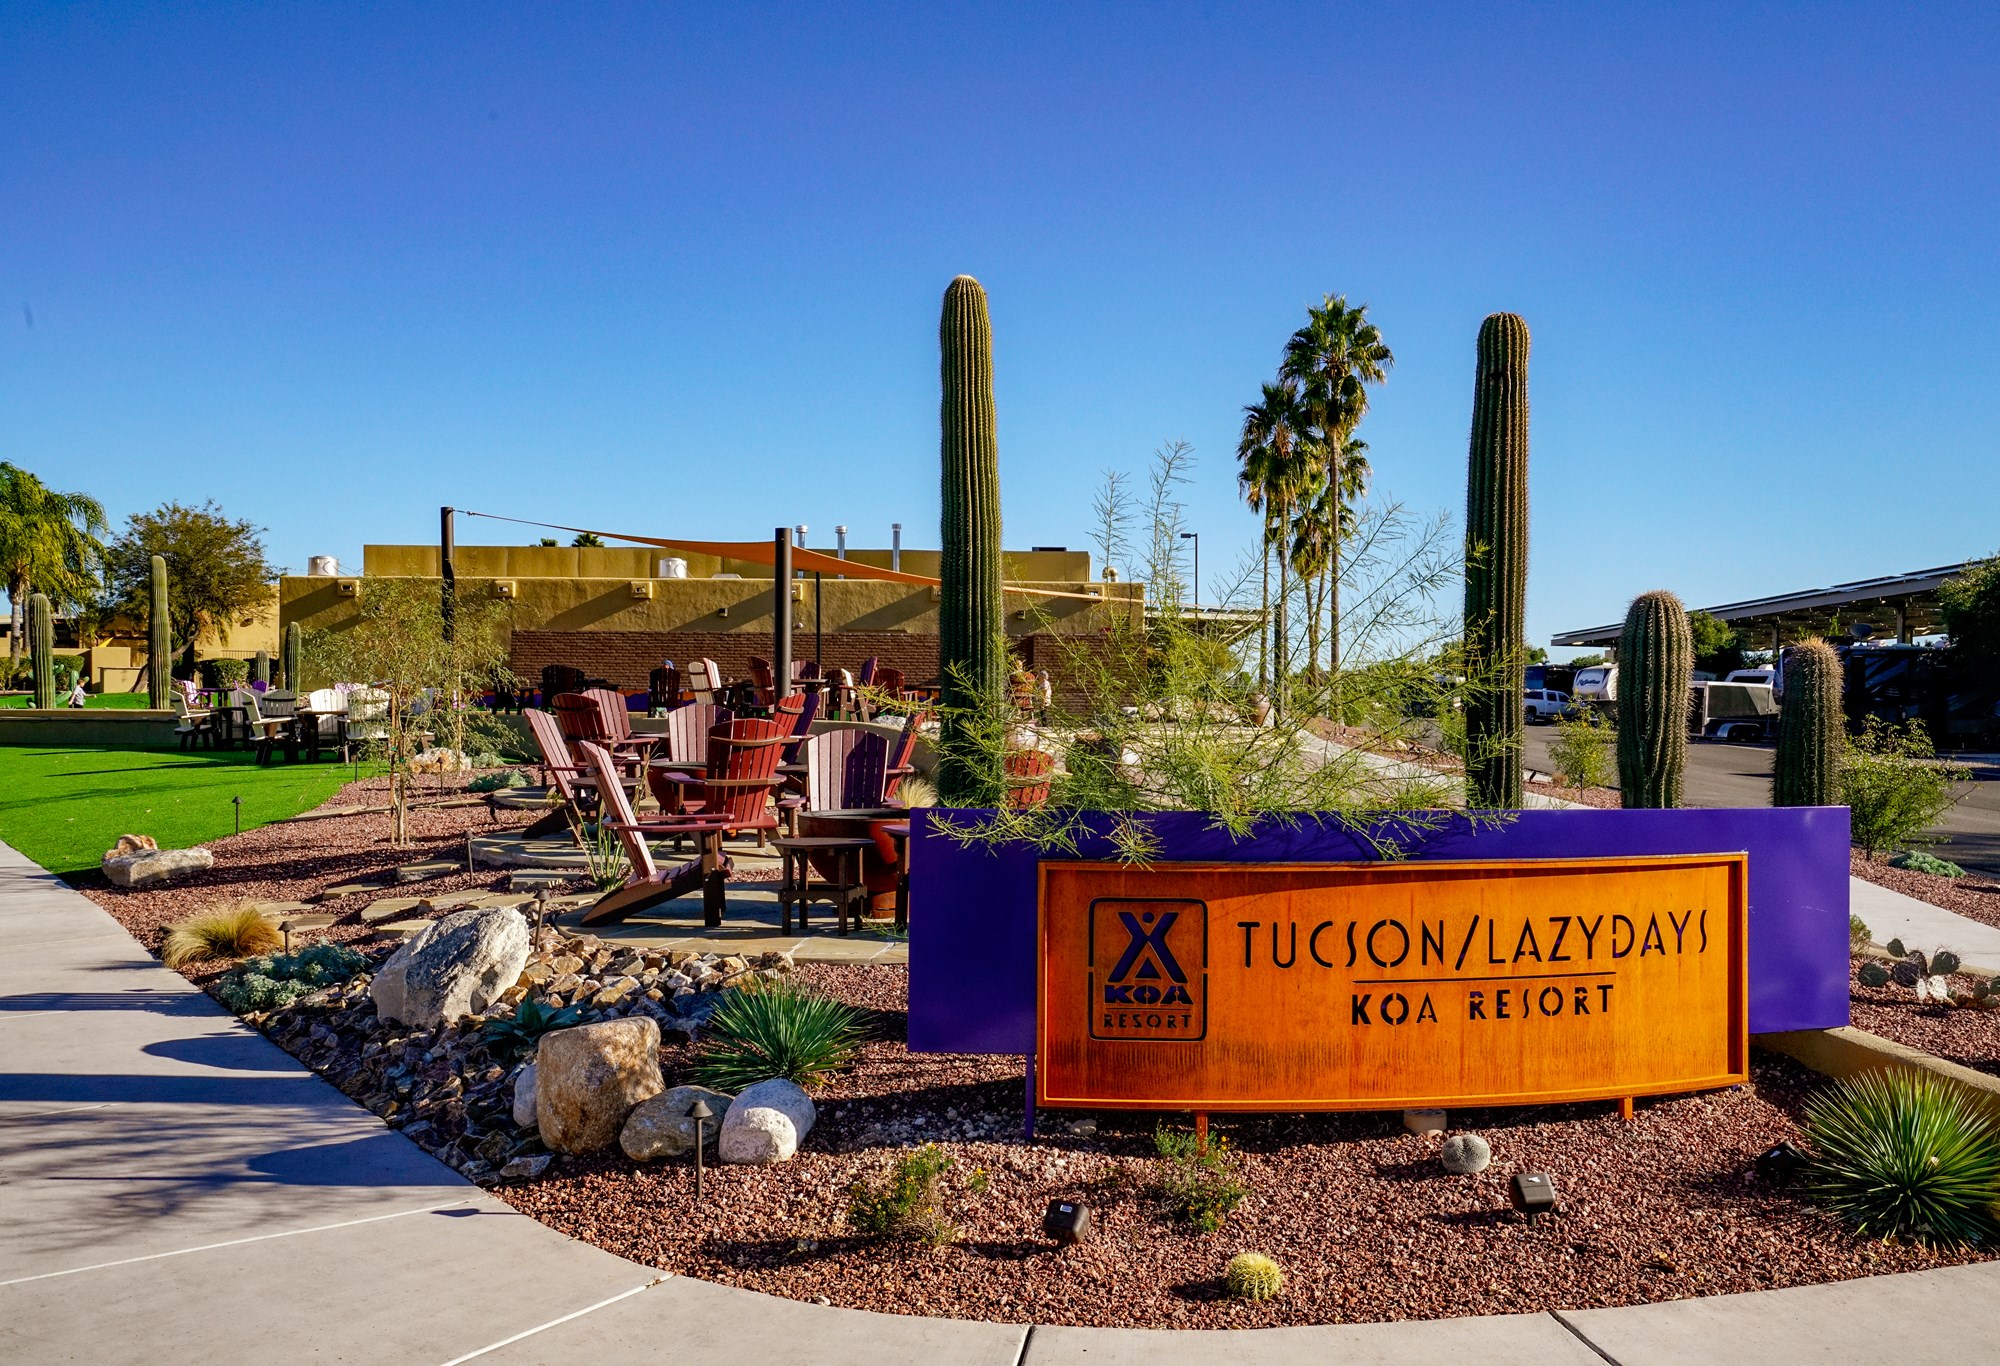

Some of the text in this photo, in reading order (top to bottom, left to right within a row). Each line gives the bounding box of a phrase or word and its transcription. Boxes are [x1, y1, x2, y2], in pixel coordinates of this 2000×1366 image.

[1237, 910, 1707, 971] TUCSON/LAZYDAYS
[1104, 984, 1194, 1005] KOA
[1352, 984, 1614, 1025] KOA RESORT
[1104, 1013, 1192, 1029] RESORT
